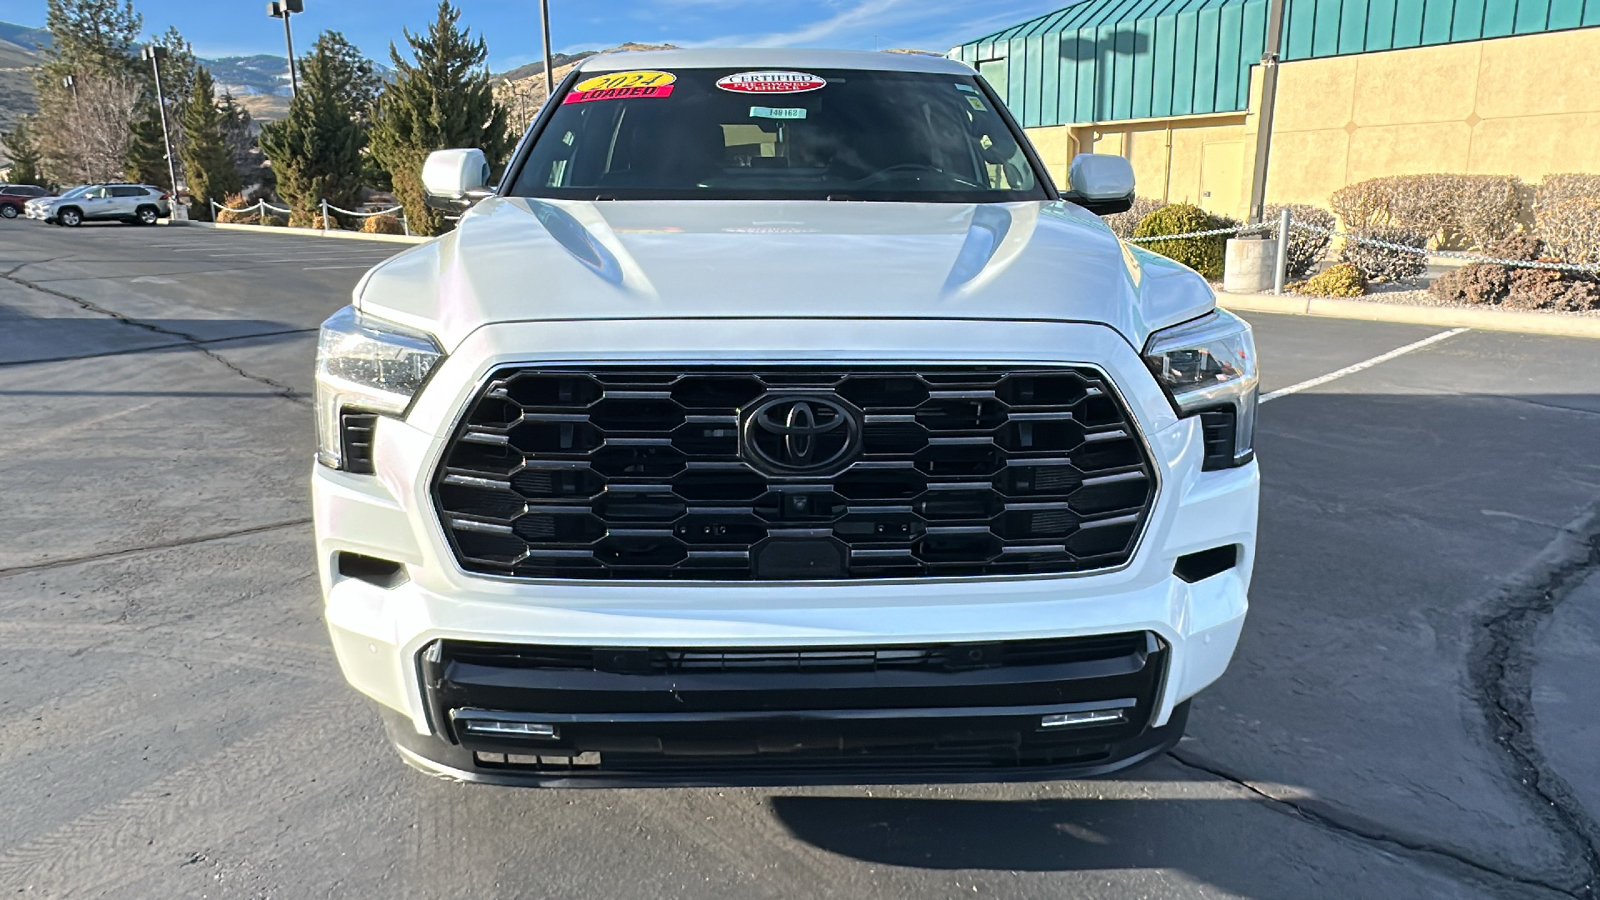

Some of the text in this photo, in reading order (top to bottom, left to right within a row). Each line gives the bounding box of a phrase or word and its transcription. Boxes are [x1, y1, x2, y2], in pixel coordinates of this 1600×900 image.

[590, 74, 664, 90] 2024
[729, 75, 813, 83] CERTIFIED
[581, 86, 658, 100] LOADED
